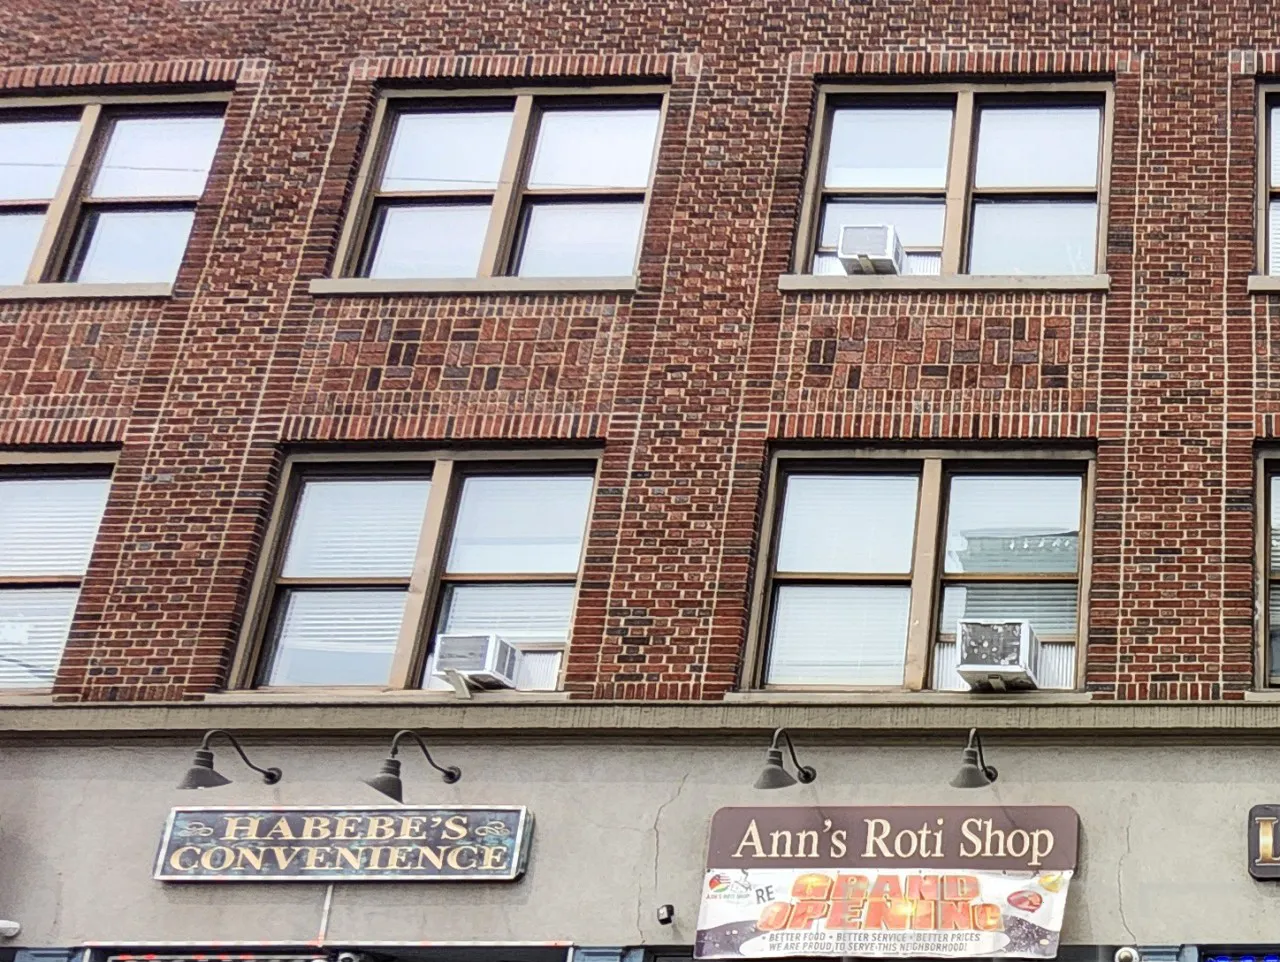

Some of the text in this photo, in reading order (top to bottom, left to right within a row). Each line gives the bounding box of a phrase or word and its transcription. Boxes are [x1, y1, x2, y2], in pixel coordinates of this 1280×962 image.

[220, 815, 469, 842] HABEBE'S
[731, 817, 1055, 867] Ann's Roti Shop
[169, 845, 509, 872] CONVENIENCE
[756, 885, 775, 905] RE
[791, 873, 983, 901] GRAND
[757, 899, 1005, 932] OPENING
[769, 932, 981, 942] BETTER FOOD BETTER SERVICE BETTER PRICES
[769, 942, 782, 951] WE
[784, 942, 801, 951] ARE
[802, 942, 832, 952] PROUD
[834, 942, 846, 952] TO
[847, 942, 875, 952] SERVE
[877, 942, 898, 952] THIS
